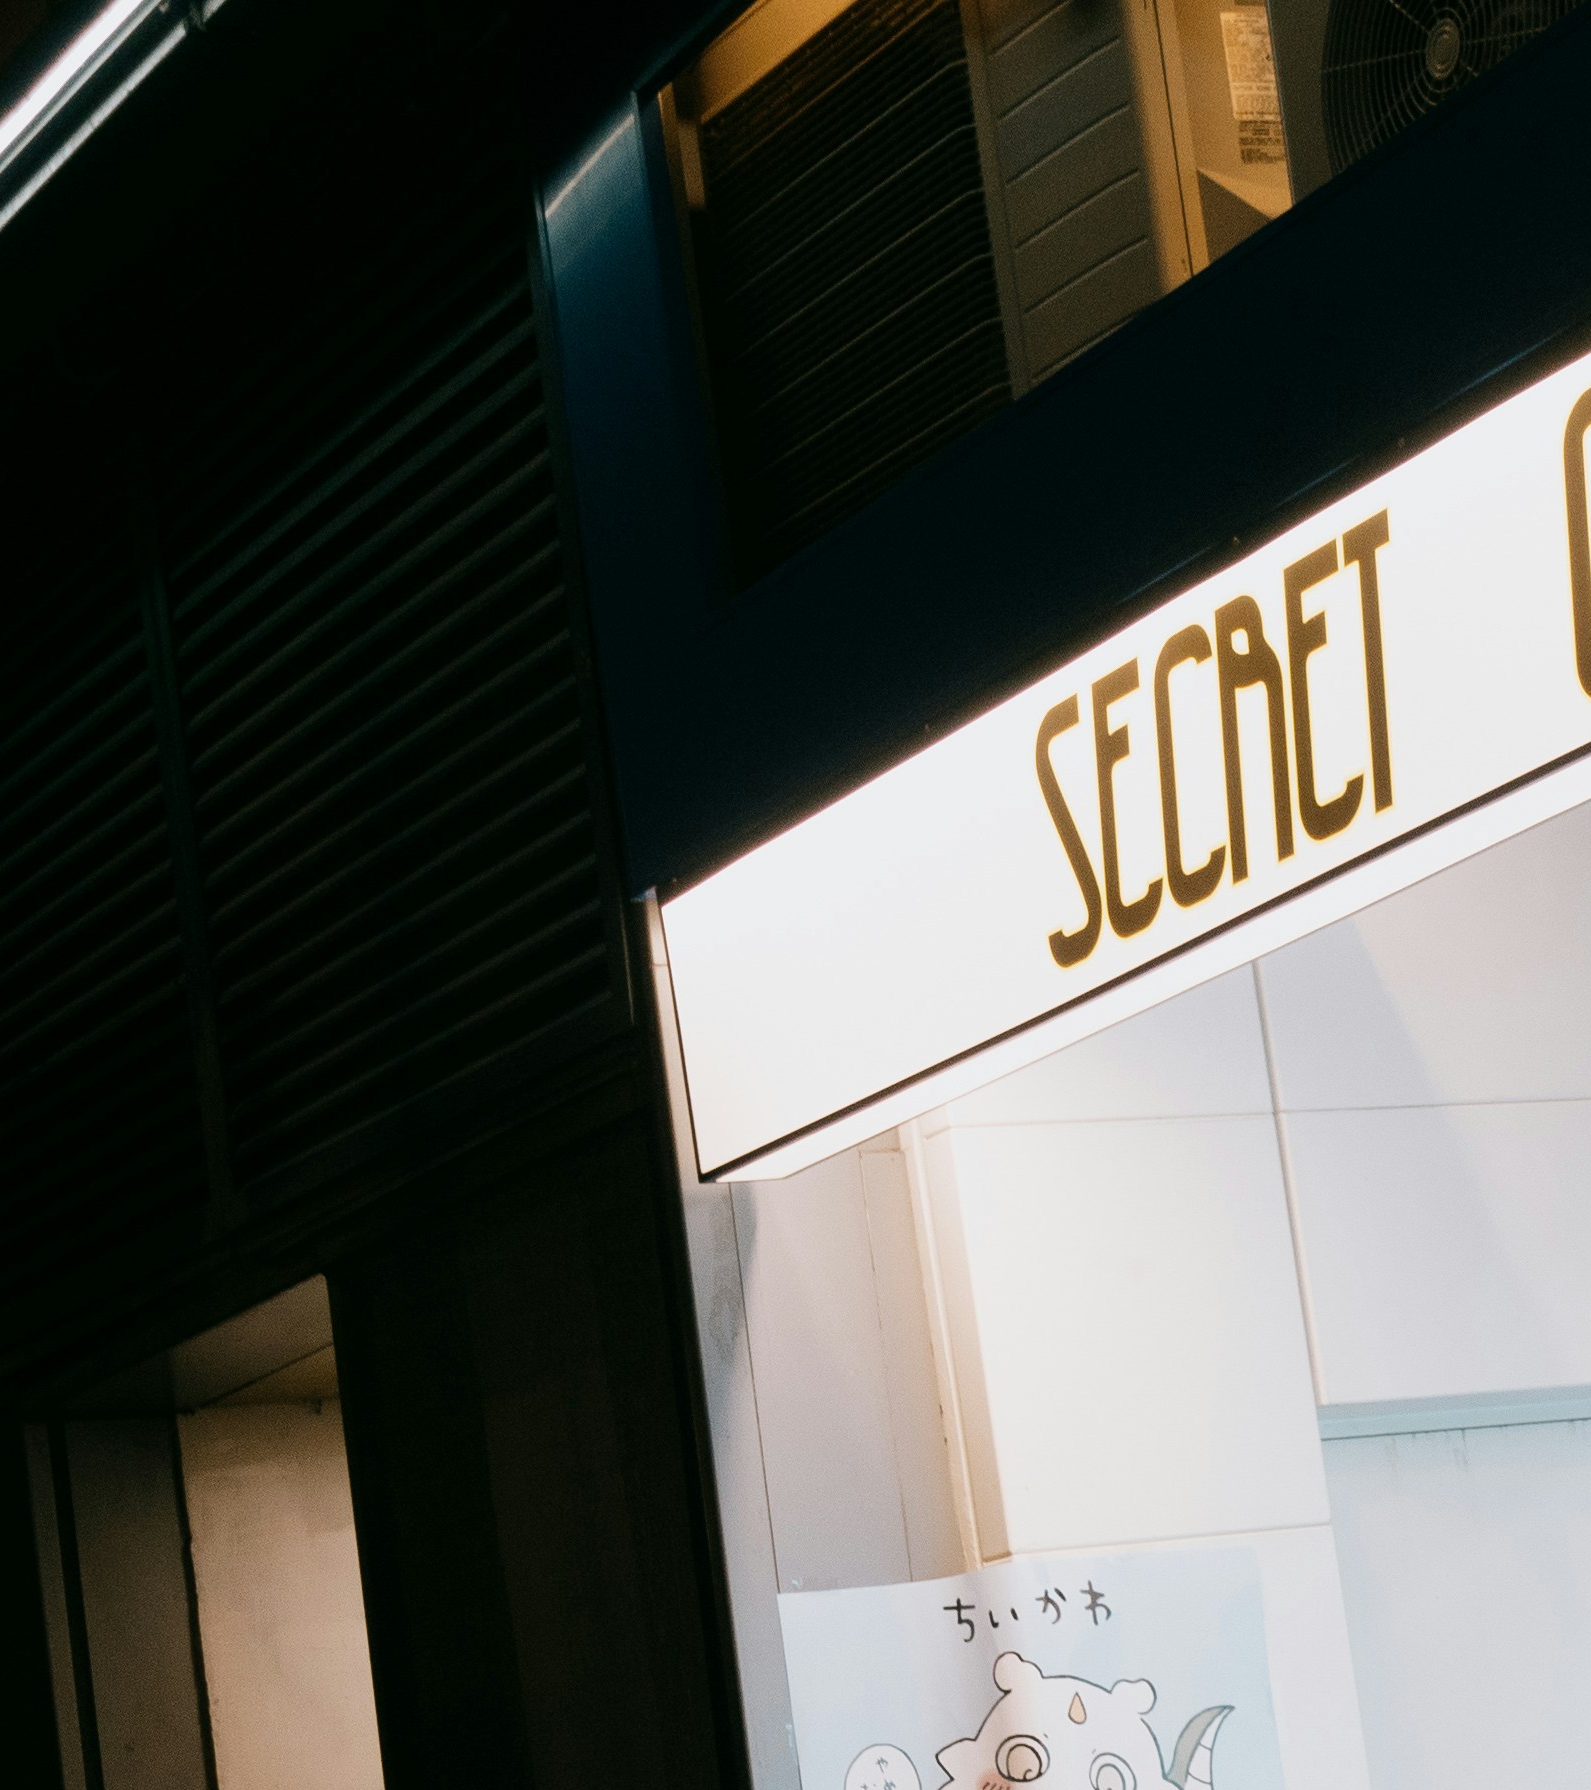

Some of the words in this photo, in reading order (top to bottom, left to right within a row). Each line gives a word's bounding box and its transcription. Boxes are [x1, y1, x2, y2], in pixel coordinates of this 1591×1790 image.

[1035, 506, 1393, 969] SECRET
[943, 1581, 1111, 1642] ちいかわ
